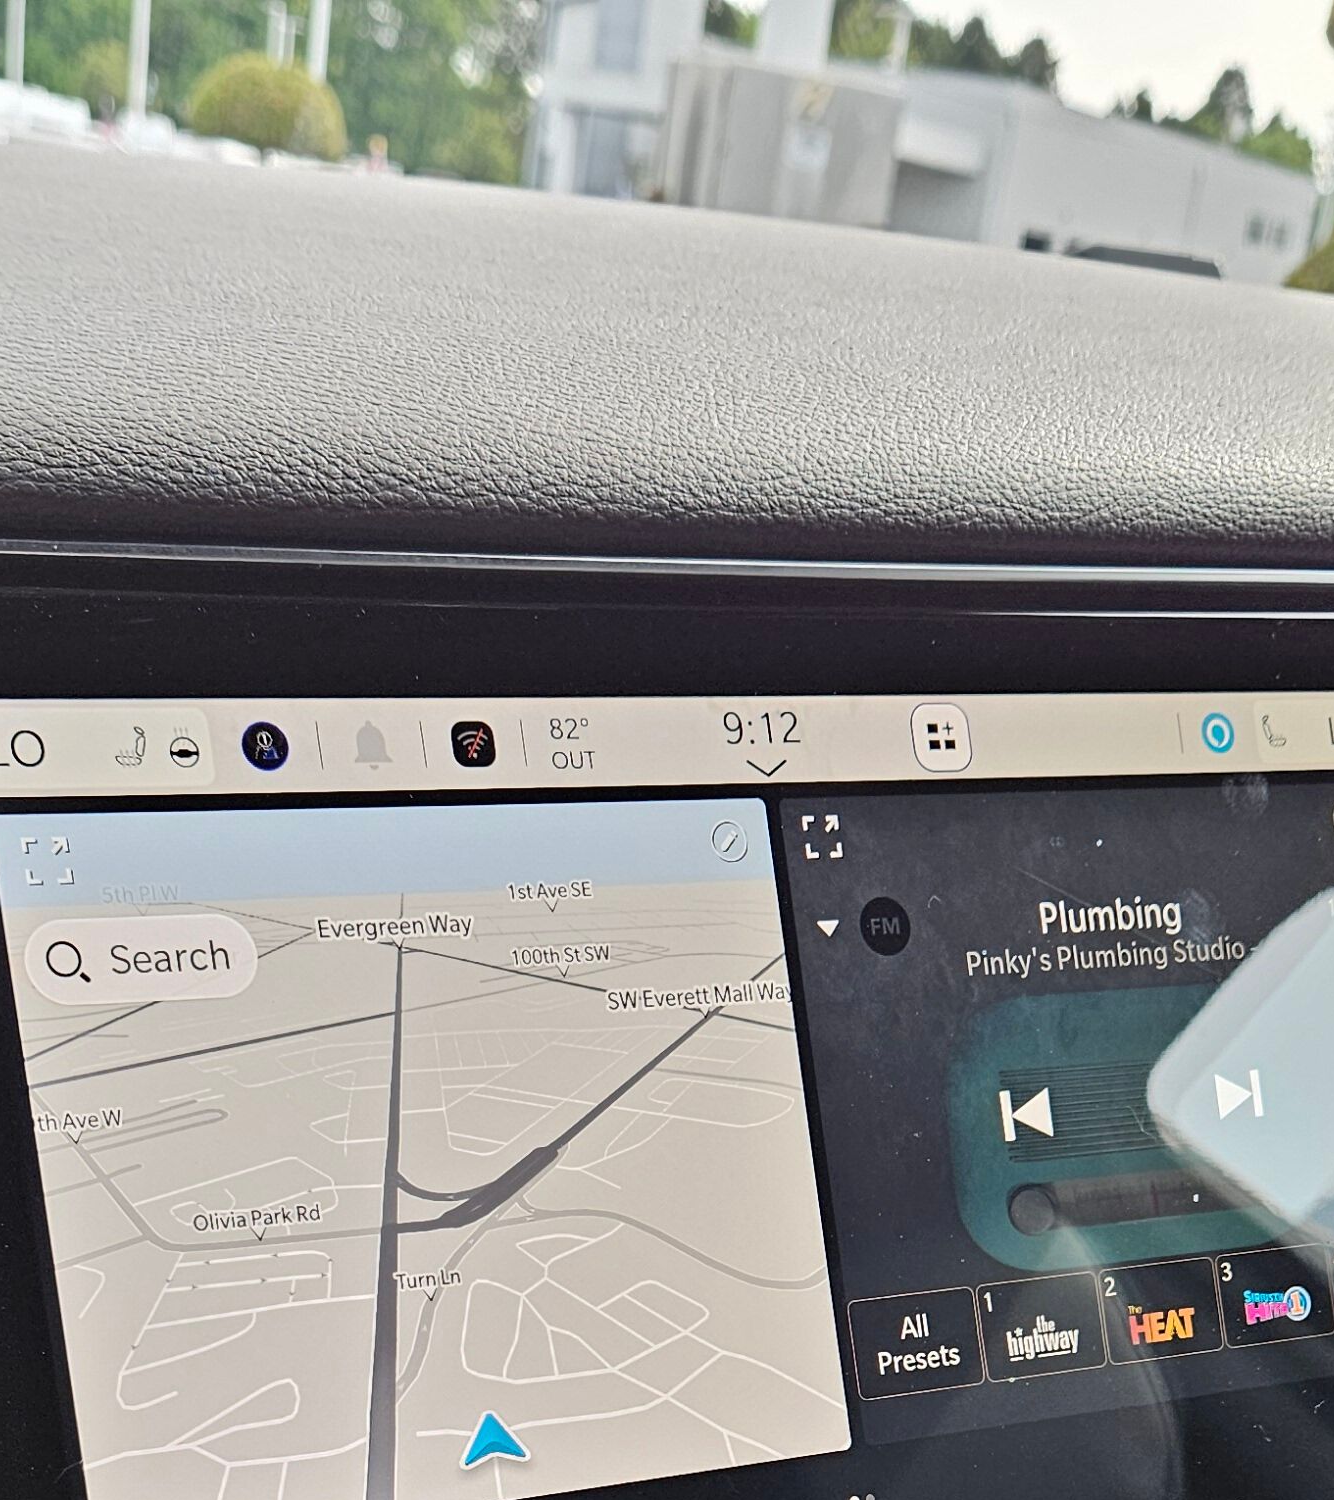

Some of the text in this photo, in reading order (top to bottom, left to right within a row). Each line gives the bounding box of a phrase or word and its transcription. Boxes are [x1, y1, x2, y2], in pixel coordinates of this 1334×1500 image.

[723, 711, 802, 747] 9:12
[551, 750, 595, 771] OUT
[508, 881, 592, 900] 1st Ave SE
[317, 913, 472, 941] Evergreen Way
[870, 917, 901, 937] FM
[1039, 896, 1183, 934] Plumbing
[110, 940, 230, 974] Search
[512, 946, 611, 966] 100th St SW
[967, 936, 1245, 979] Pinky's Plumbing Studio
[607, 990, 637, 1010] SW
[643, 987, 710, 1008] Everett
[714, 982, 753, 1003] Mall
[63, 1112, 99, 1130] Ave
[102, 1109, 121, 1126] W
[193, 1204, 321, 1231] Olivia Park Rd
[395, 1269, 461, 1290] Turn Ln
[1220, 1262, 1233, 1282] 3
[1104, 1277, 1117, 1297] 2
[984, 1292, 993, 1313] 1
[900, 1313, 930, 1340] All
[1036, 1315, 1056, 1333] the
[1128, 1307, 1195, 1345] HEAT
[1006, 1328, 1079, 1360] highway
[877, 1345, 961, 1375] Presets
